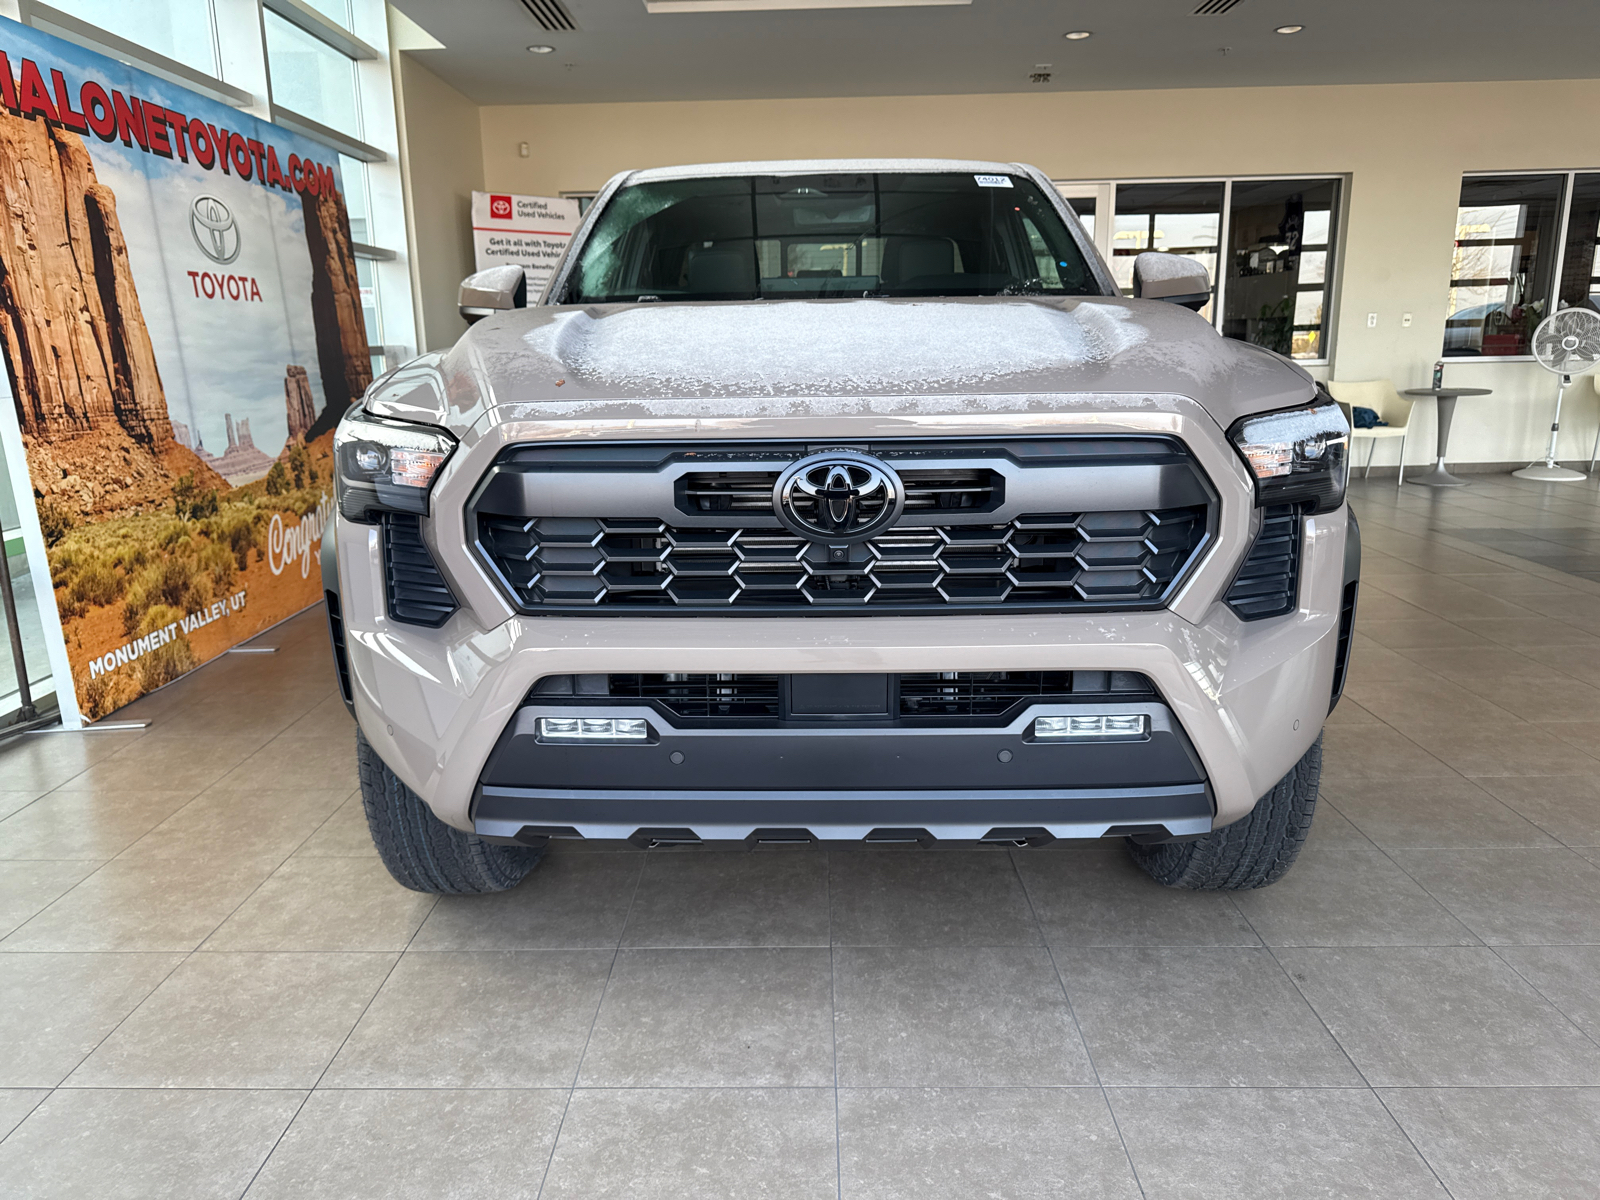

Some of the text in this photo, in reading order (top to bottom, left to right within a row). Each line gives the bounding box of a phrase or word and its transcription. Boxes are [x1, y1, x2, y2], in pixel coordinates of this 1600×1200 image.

[517, 200, 547, 209] Certified
[517, 209, 565, 220] Used Vehicles
[489, 238, 504, 246] Get
[505, 238, 511, 246] it
[513, 239, 523, 247] all
[524, 240, 541, 248] with
[485, 248, 519, 256] Certified
[521, 249, 540, 257] Used
[187, 270, 263, 302] TOYOTA
[88, 590, 247, 680] MONUMENT VALLEY, UT
